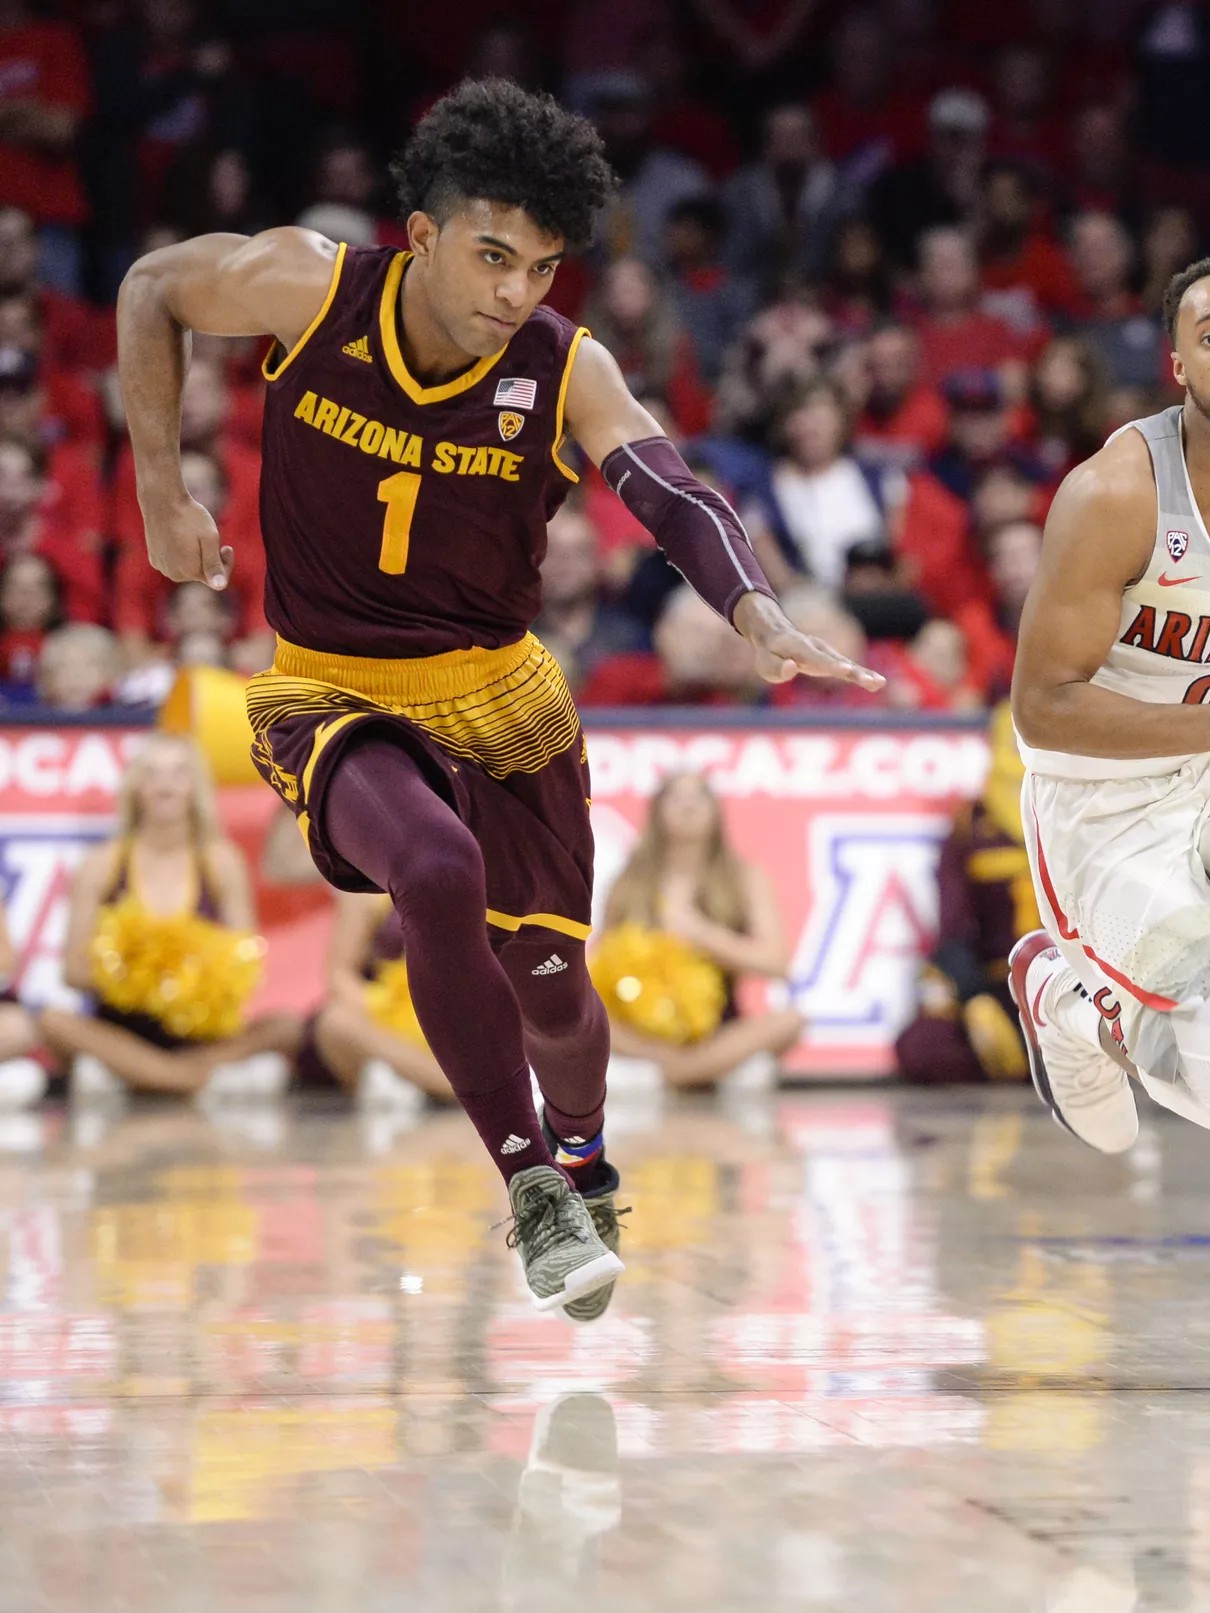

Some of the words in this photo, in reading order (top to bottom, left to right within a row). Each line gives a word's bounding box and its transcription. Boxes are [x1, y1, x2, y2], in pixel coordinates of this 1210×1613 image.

[342, 345, 373, 363] adidas
[294, 390, 424, 468] ARIZONA
[431, 441, 524, 482] STATE
[376, 471, 422, 575] 1
[1167, 532, 1187, 551] PAC
[1170, 543, 1182, 557] 12
[531, 961, 568, 976] adidas
[500, 1137, 531, 1155] adidas
